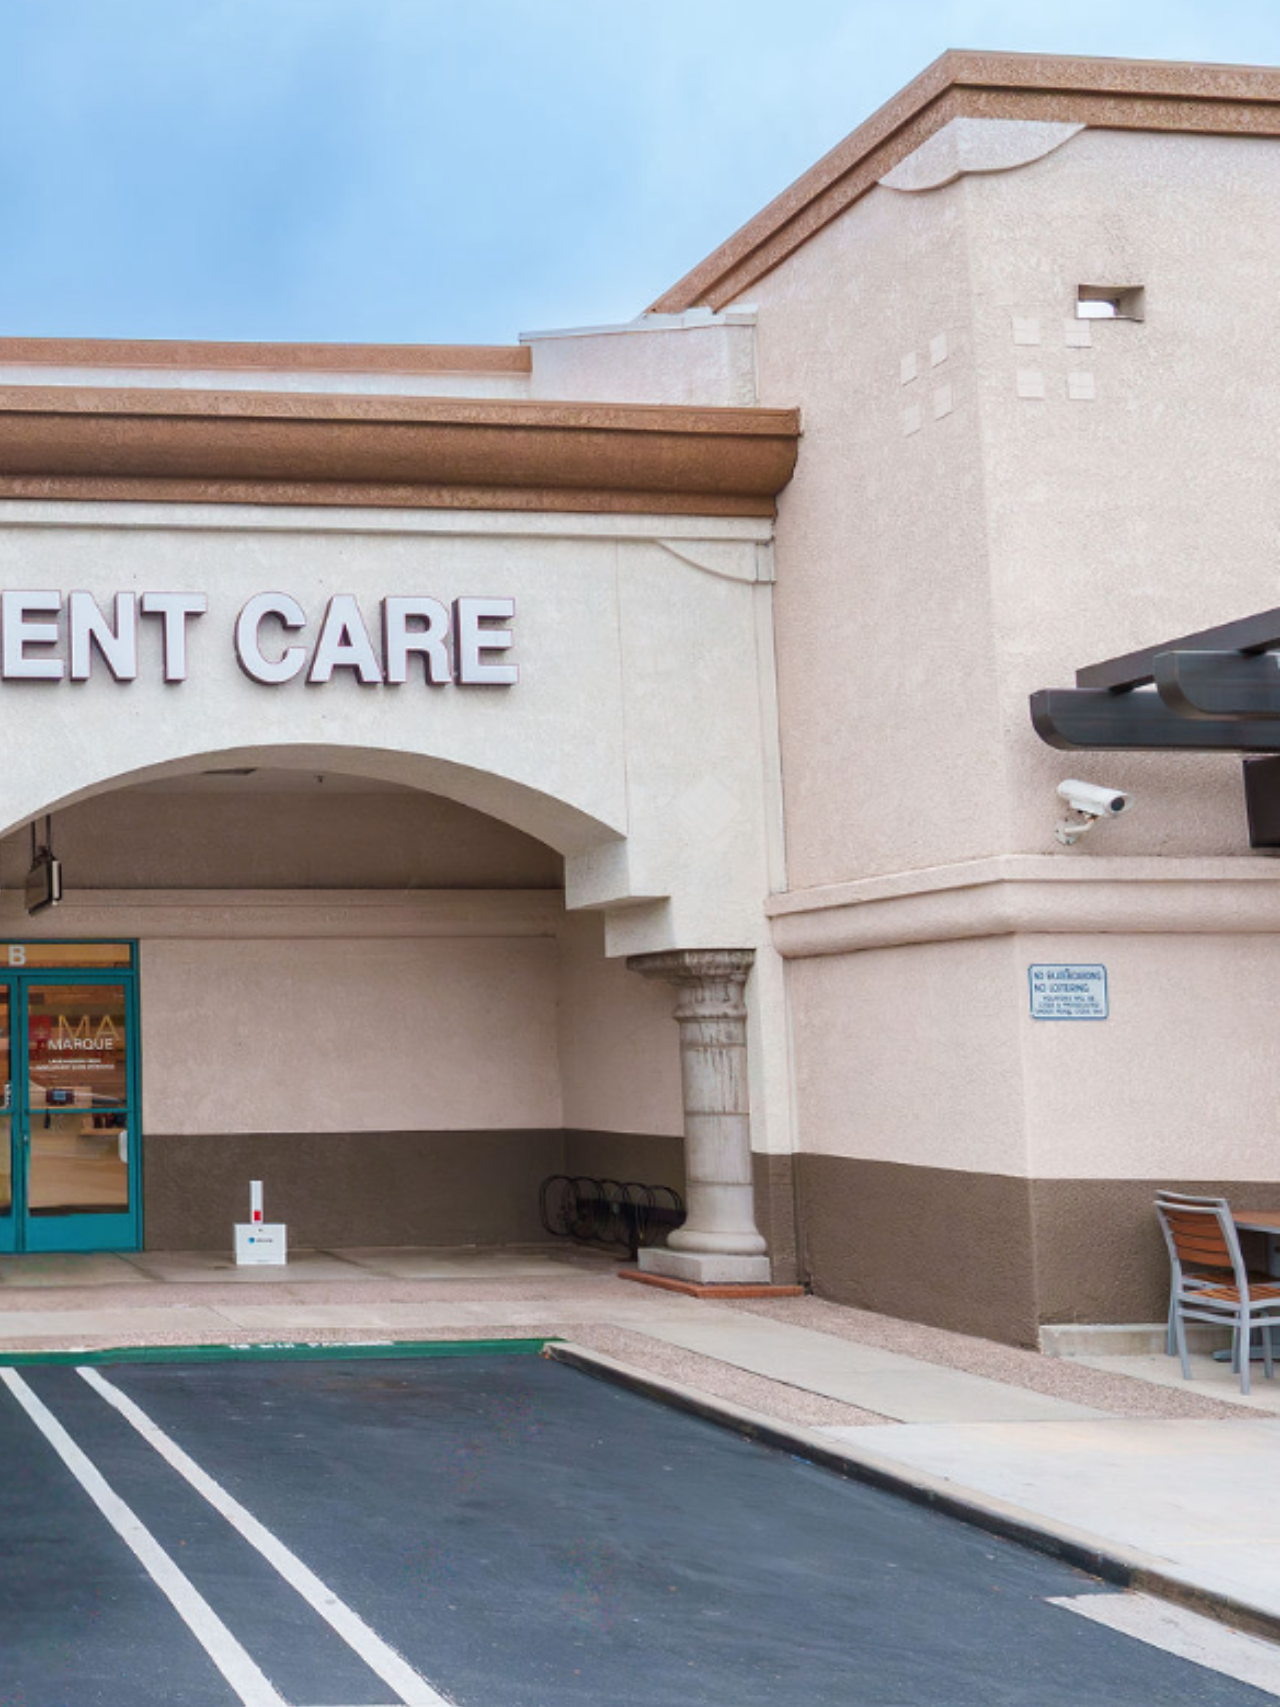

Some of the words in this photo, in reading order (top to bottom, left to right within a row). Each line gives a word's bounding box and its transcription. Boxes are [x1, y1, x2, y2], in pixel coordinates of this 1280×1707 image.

[234, 591, 520, 686] CARE
[8, 945, 26, 966] B
[47, 1038, 114, 1051] MARQUE
